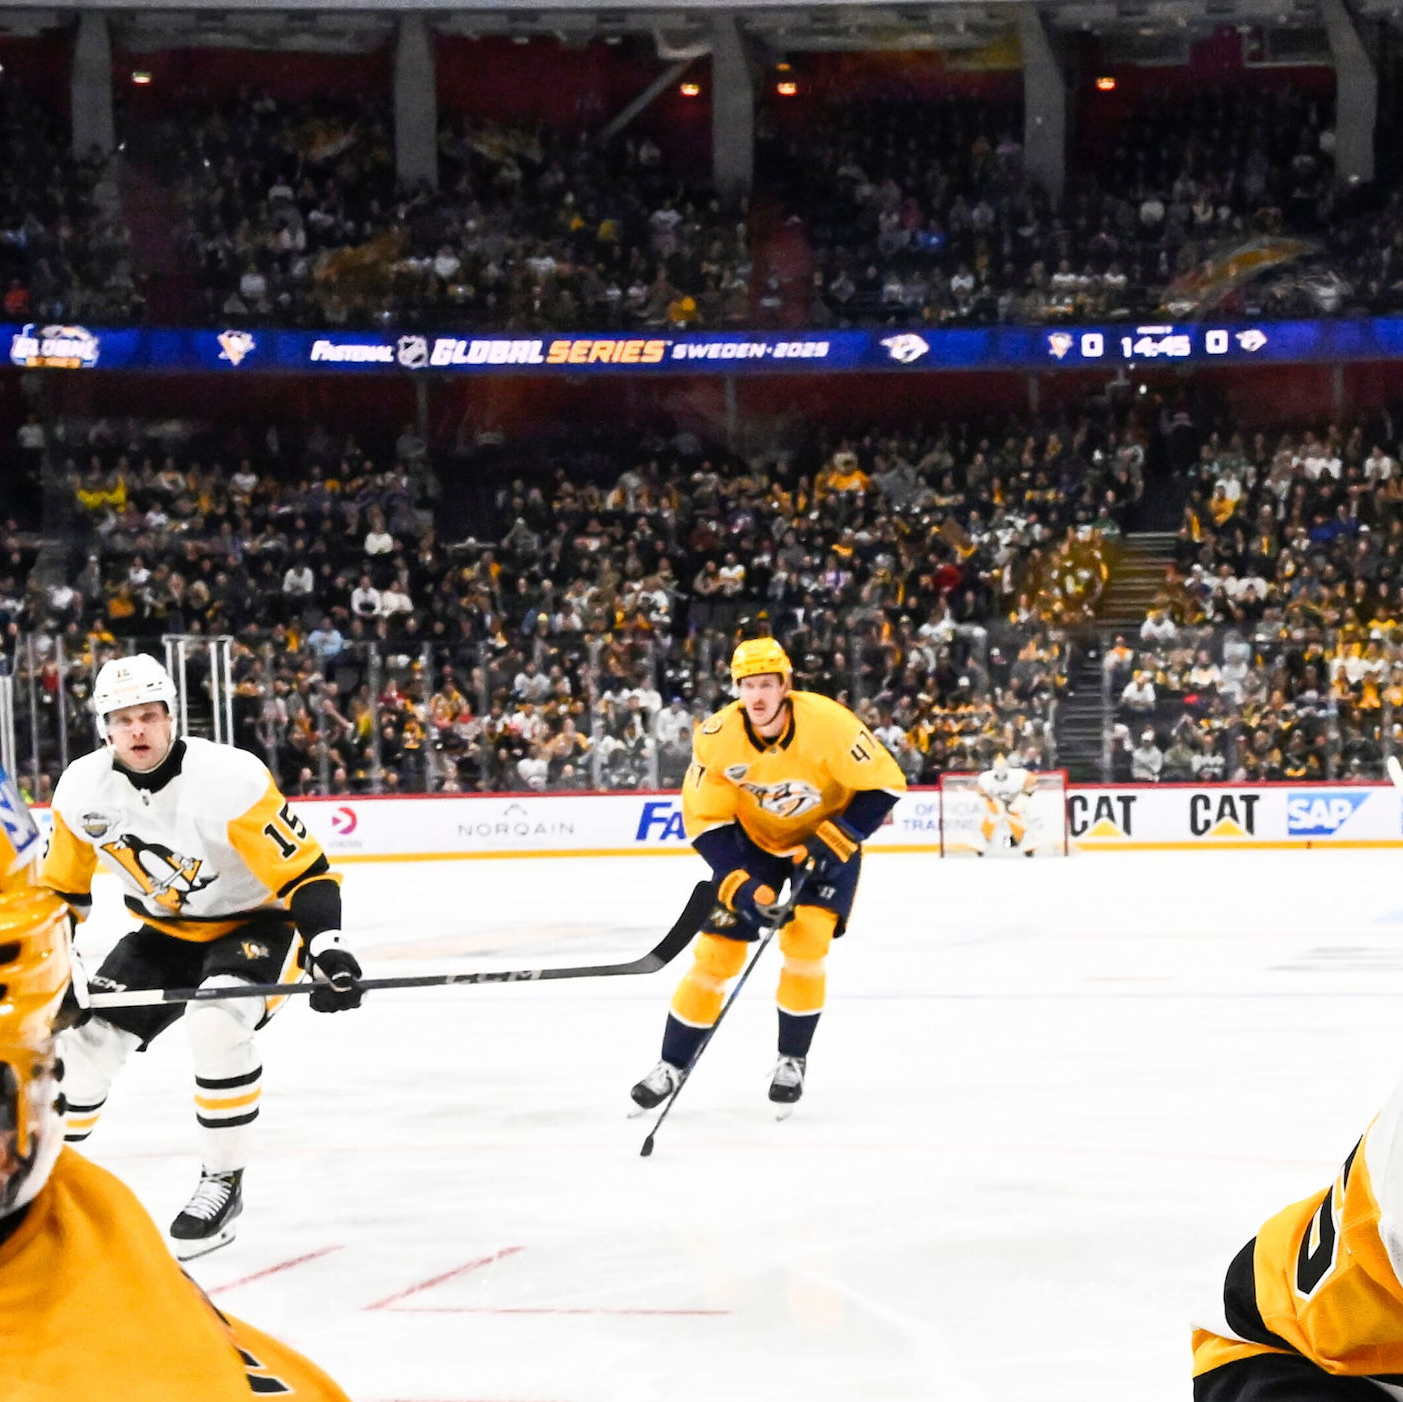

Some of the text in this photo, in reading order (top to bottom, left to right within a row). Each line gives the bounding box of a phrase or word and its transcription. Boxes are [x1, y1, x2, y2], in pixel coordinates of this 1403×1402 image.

[430, 339, 543, 365] GLOBAL
[546, 340, 666, 364] SERIES
[1081, 334, 1104, 357] 0
[1121, 335, 1191, 357] 14:45
[1205, 330, 1228, 354] 0
[1069, 795, 1138, 838] CAT
[1190, 795, 1261, 837] CAT
[1288, 798, 1353, 831] SAP
[262, 800, 309, 862] 15
[458, 822, 575, 838] NORQAIN
